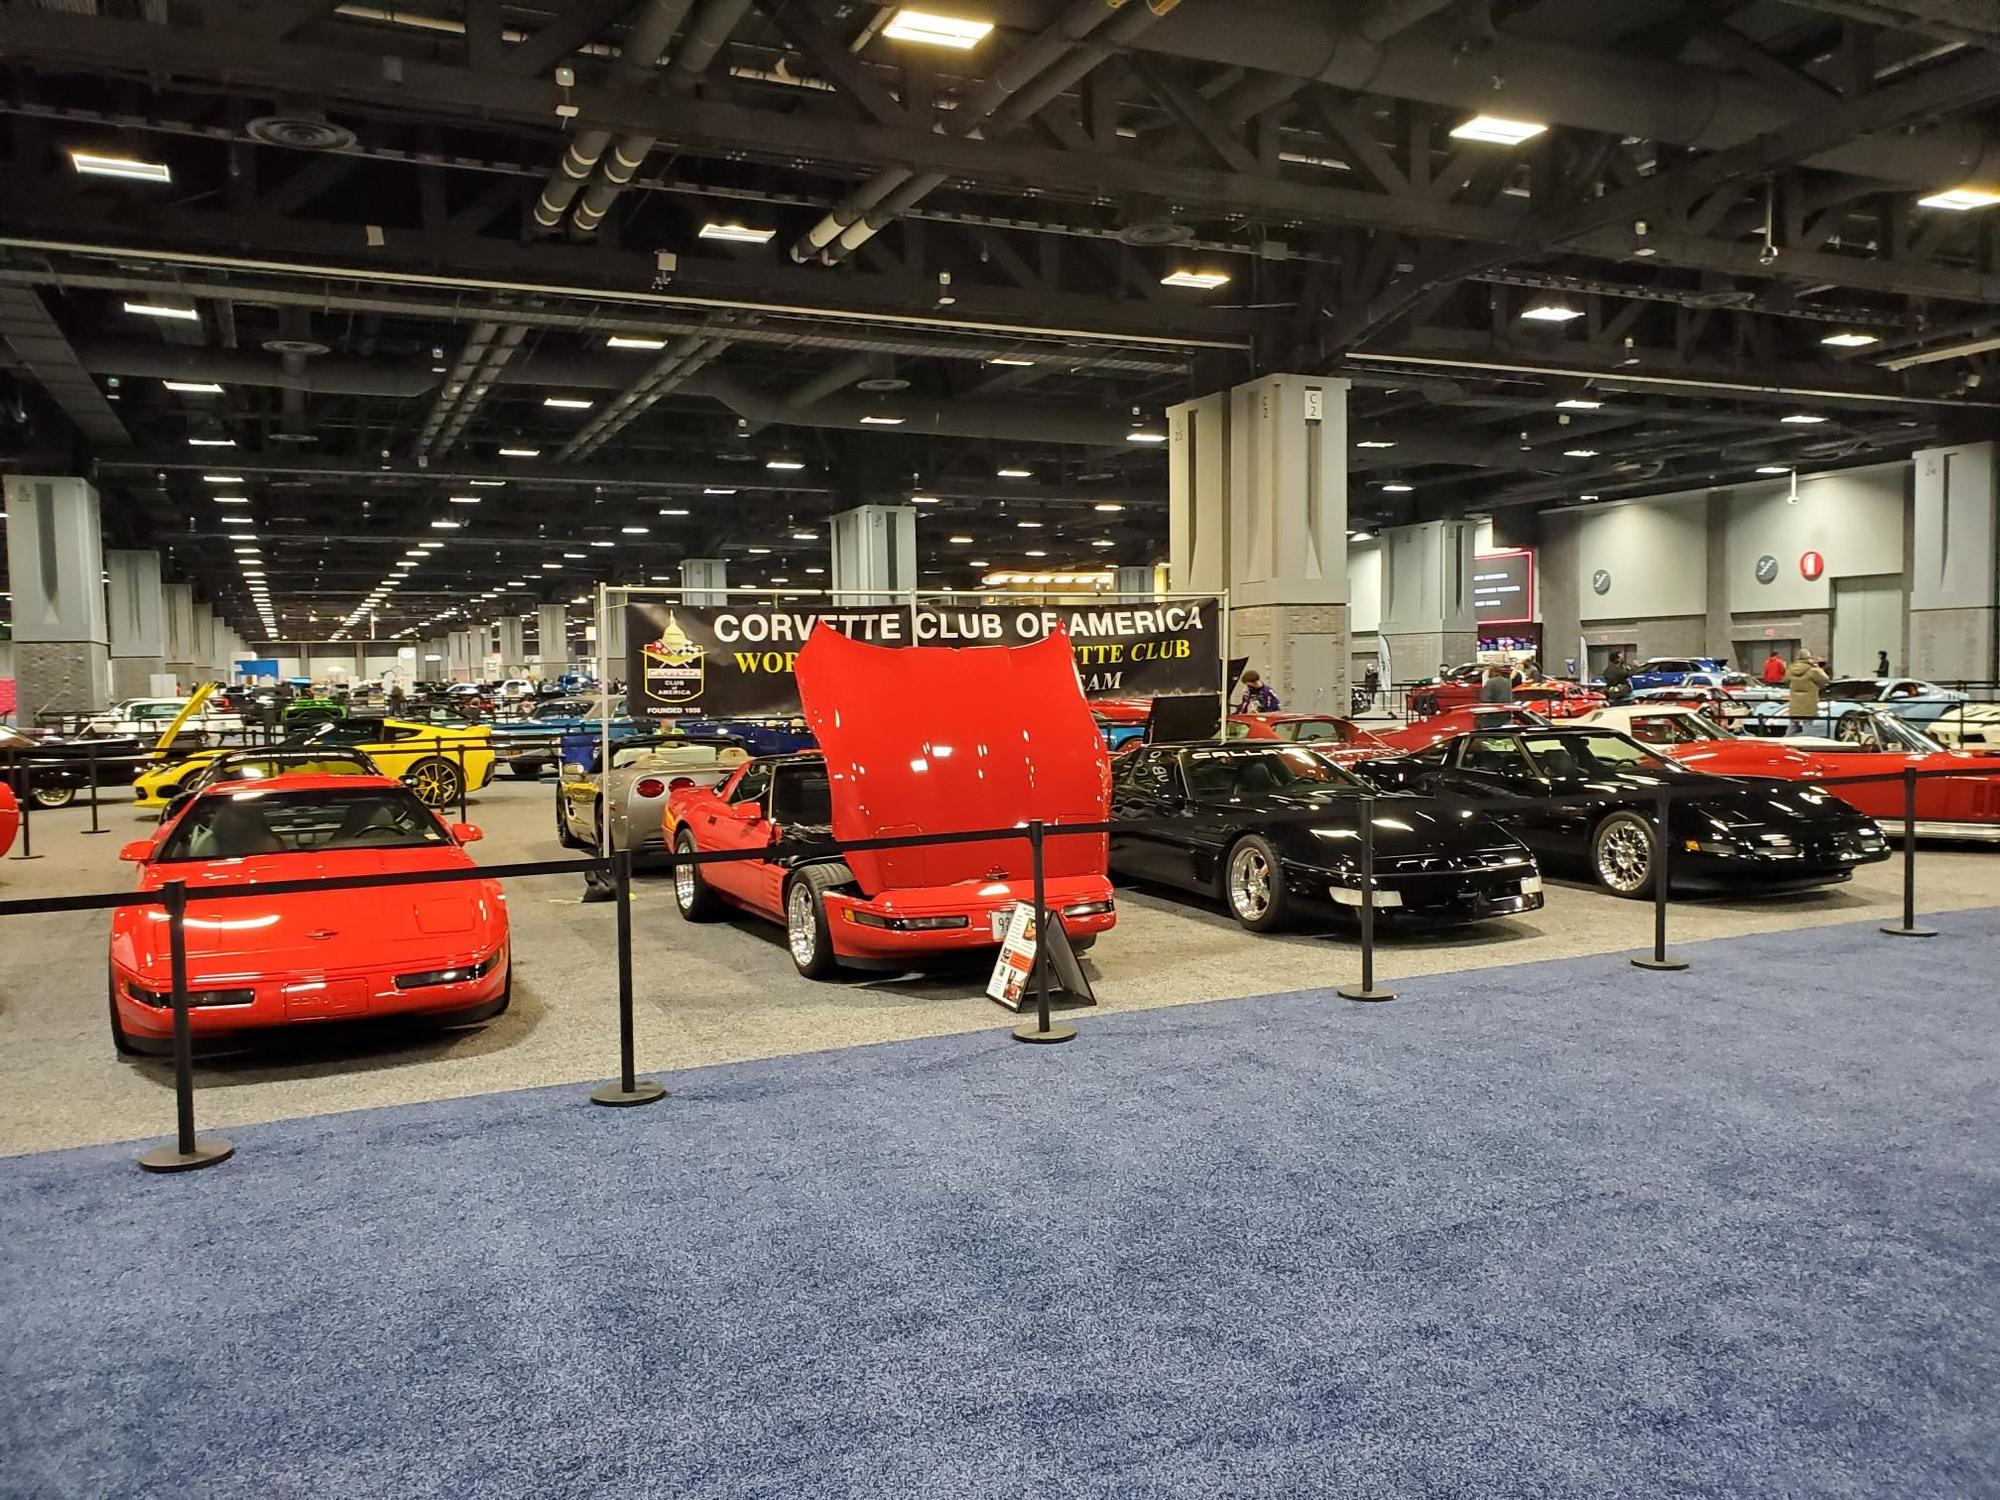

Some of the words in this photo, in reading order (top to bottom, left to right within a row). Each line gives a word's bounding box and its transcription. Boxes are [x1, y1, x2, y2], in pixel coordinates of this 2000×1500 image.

[916, 612, 1003, 639] CLUB
[1015, 612, 1058, 638] OF
[1069, 606, 1203, 637] AMERICA
[1130, 639, 1191, 662] CLUB
